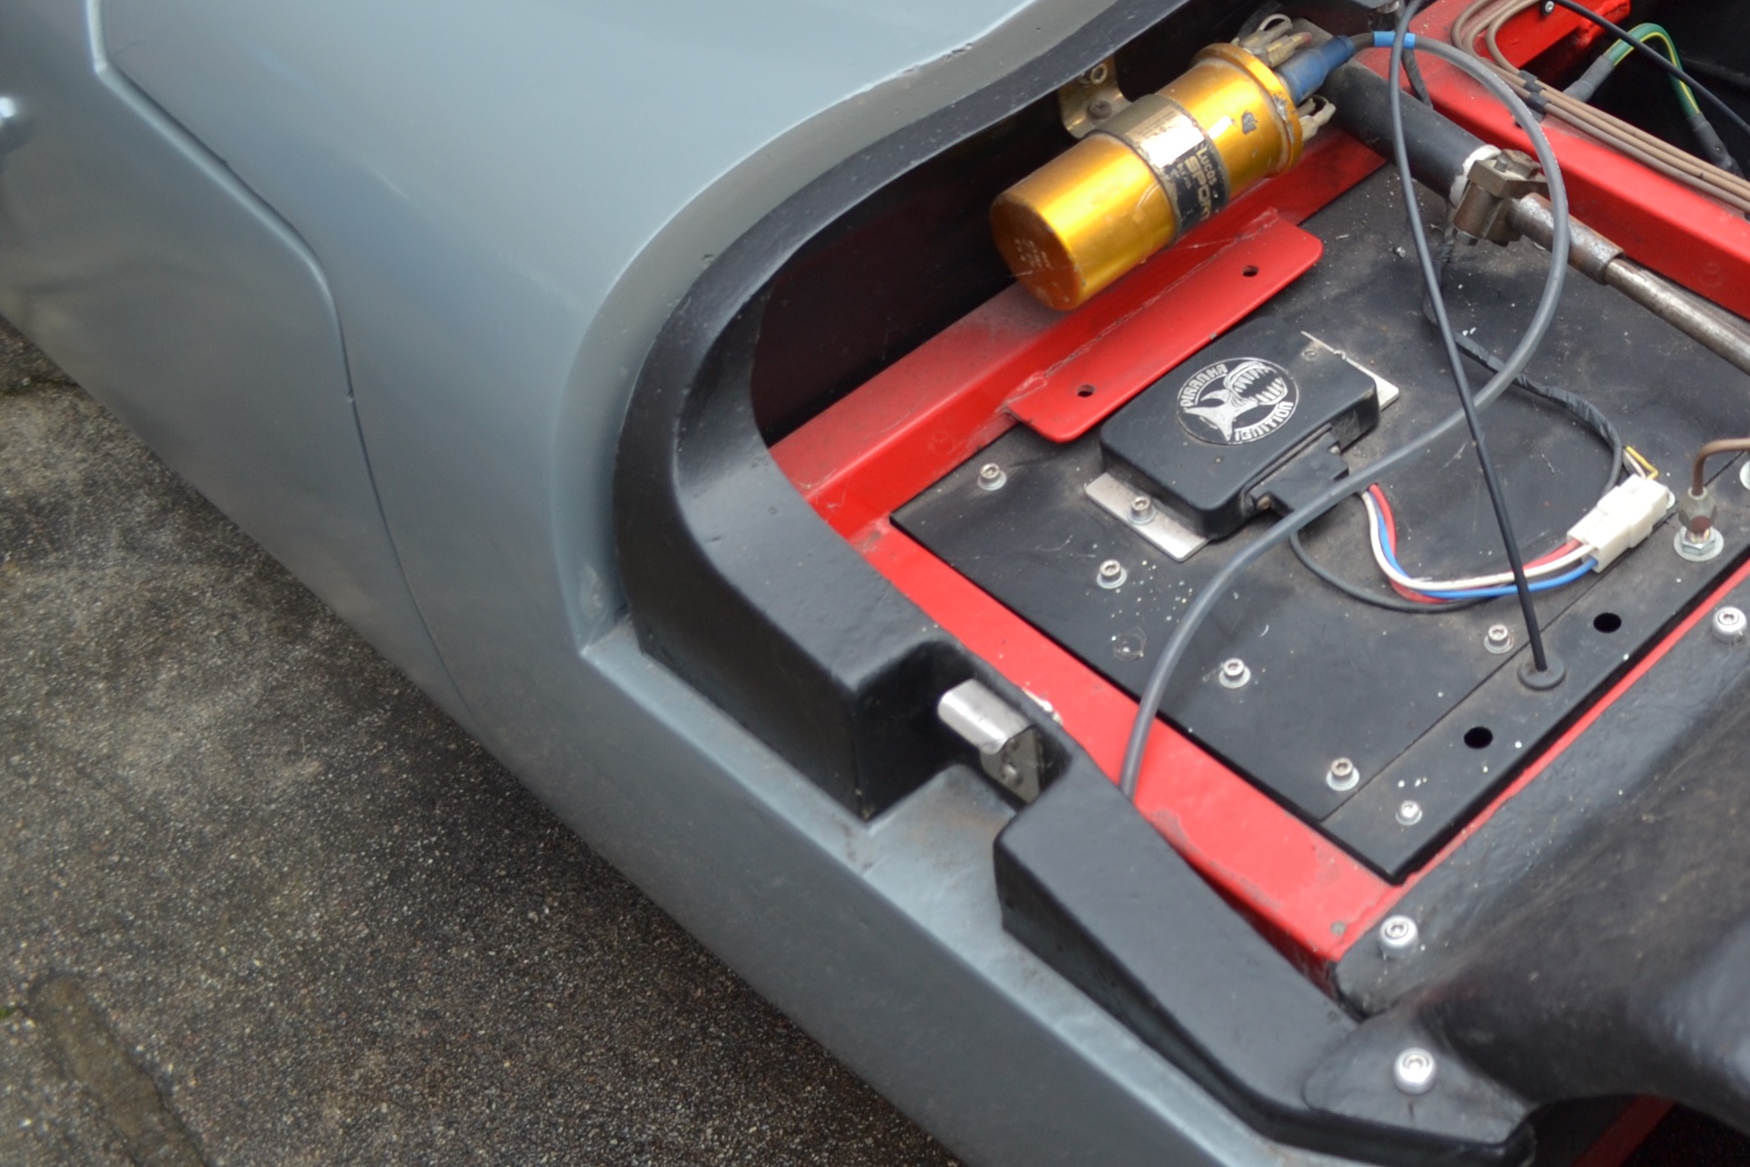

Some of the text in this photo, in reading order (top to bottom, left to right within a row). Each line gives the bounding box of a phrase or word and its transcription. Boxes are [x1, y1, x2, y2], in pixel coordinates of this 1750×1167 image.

[1196, 147, 1218, 186] Lucas
[1180, 363, 1229, 408] PIRANHA
[1235, 400, 1294, 442] IGNITION
